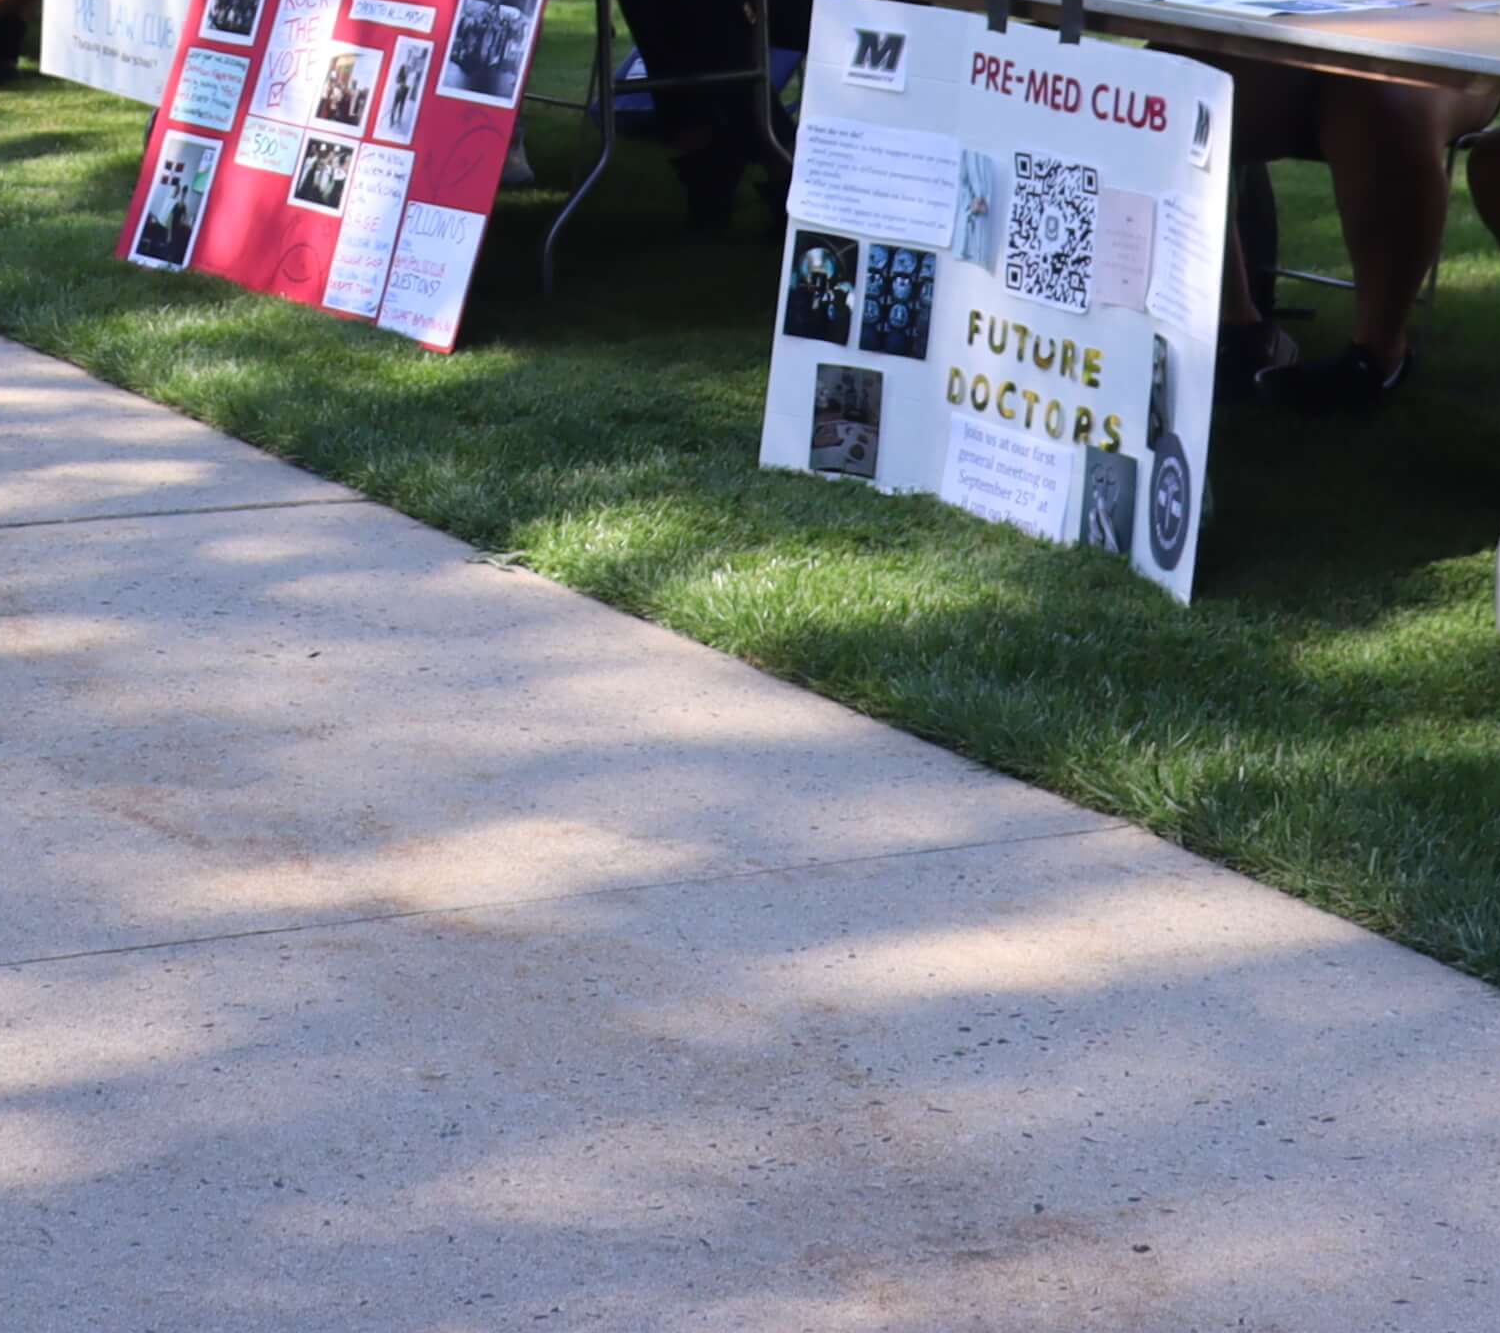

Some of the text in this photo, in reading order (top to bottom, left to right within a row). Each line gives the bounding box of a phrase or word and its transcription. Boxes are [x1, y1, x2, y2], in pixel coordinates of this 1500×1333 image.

[284, 15, 320, 43] THE
[267, 48, 320, 82] VOTE
[971, 51, 1167, 132] PRE-MED CLUB
[967, 308, 1104, 389] FUTURE
[946, 366, 1122, 454] DOCTORS
[985, 433, 997, 447] us
[998, 437, 1010, 451] at
[1032, 445, 1057, 466] first
[958, 448, 1057, 492] general meeting on
[958, 468, 1013, 500] September
